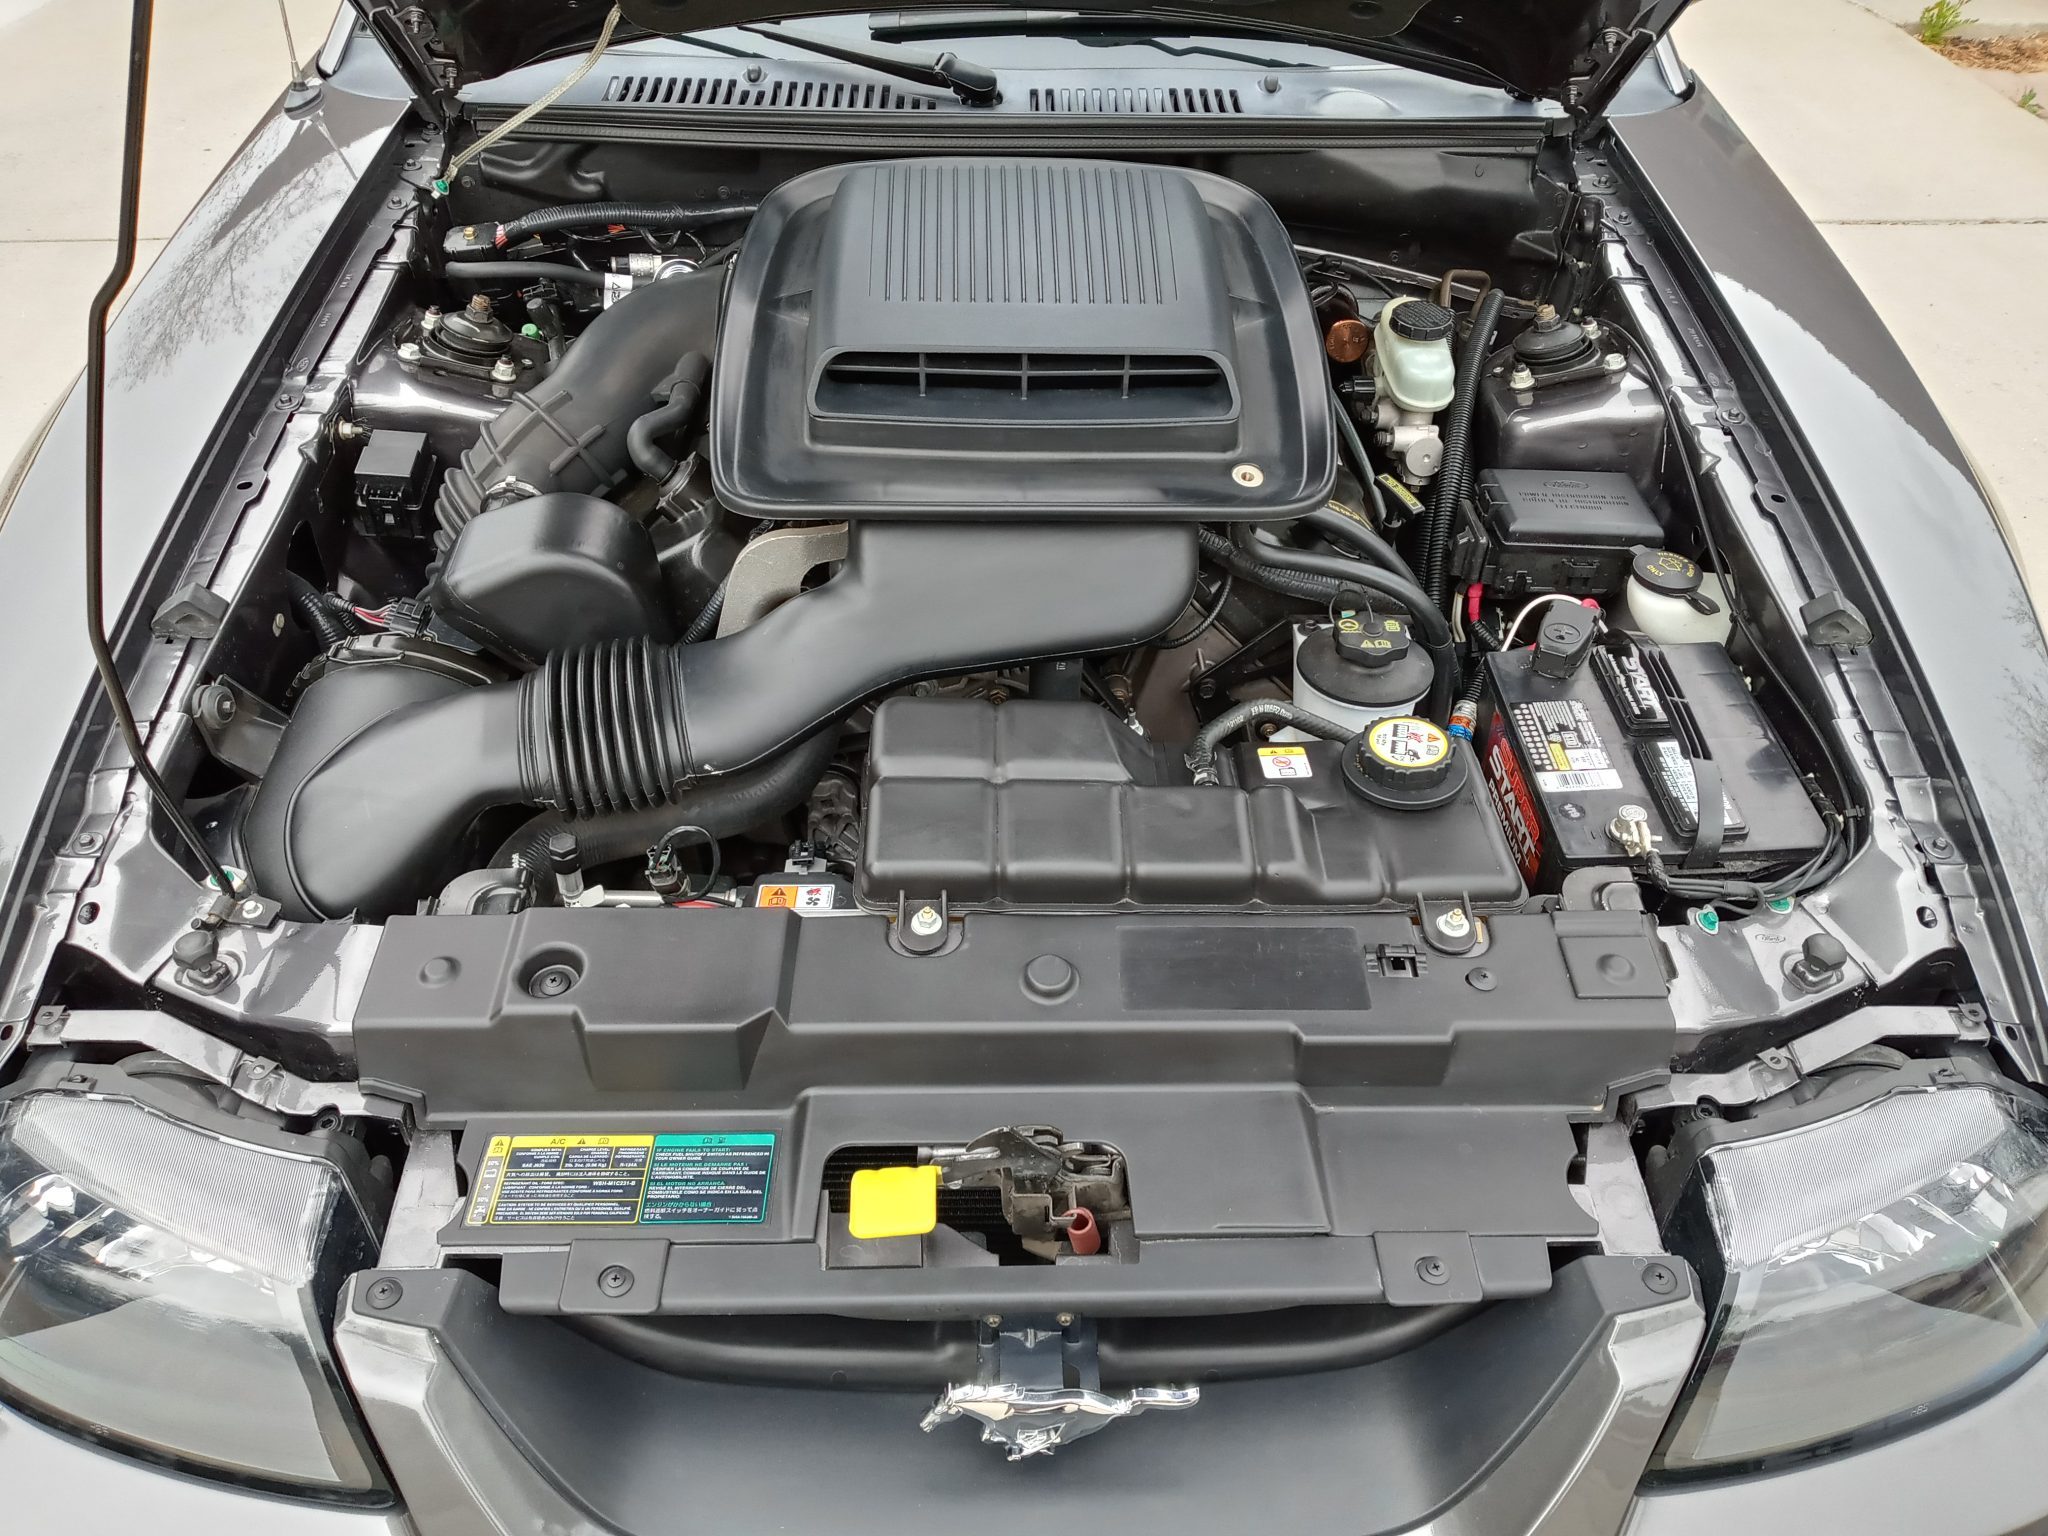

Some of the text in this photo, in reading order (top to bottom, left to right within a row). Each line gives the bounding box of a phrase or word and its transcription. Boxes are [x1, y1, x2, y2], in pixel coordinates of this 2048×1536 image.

[1646, 564, 1665, 576] ONLY
[1488, 778, 1522, 865] PREMIUM
[1489, 744, 1536, 858] START
[1500, 737, 1540, 845] SUPER
